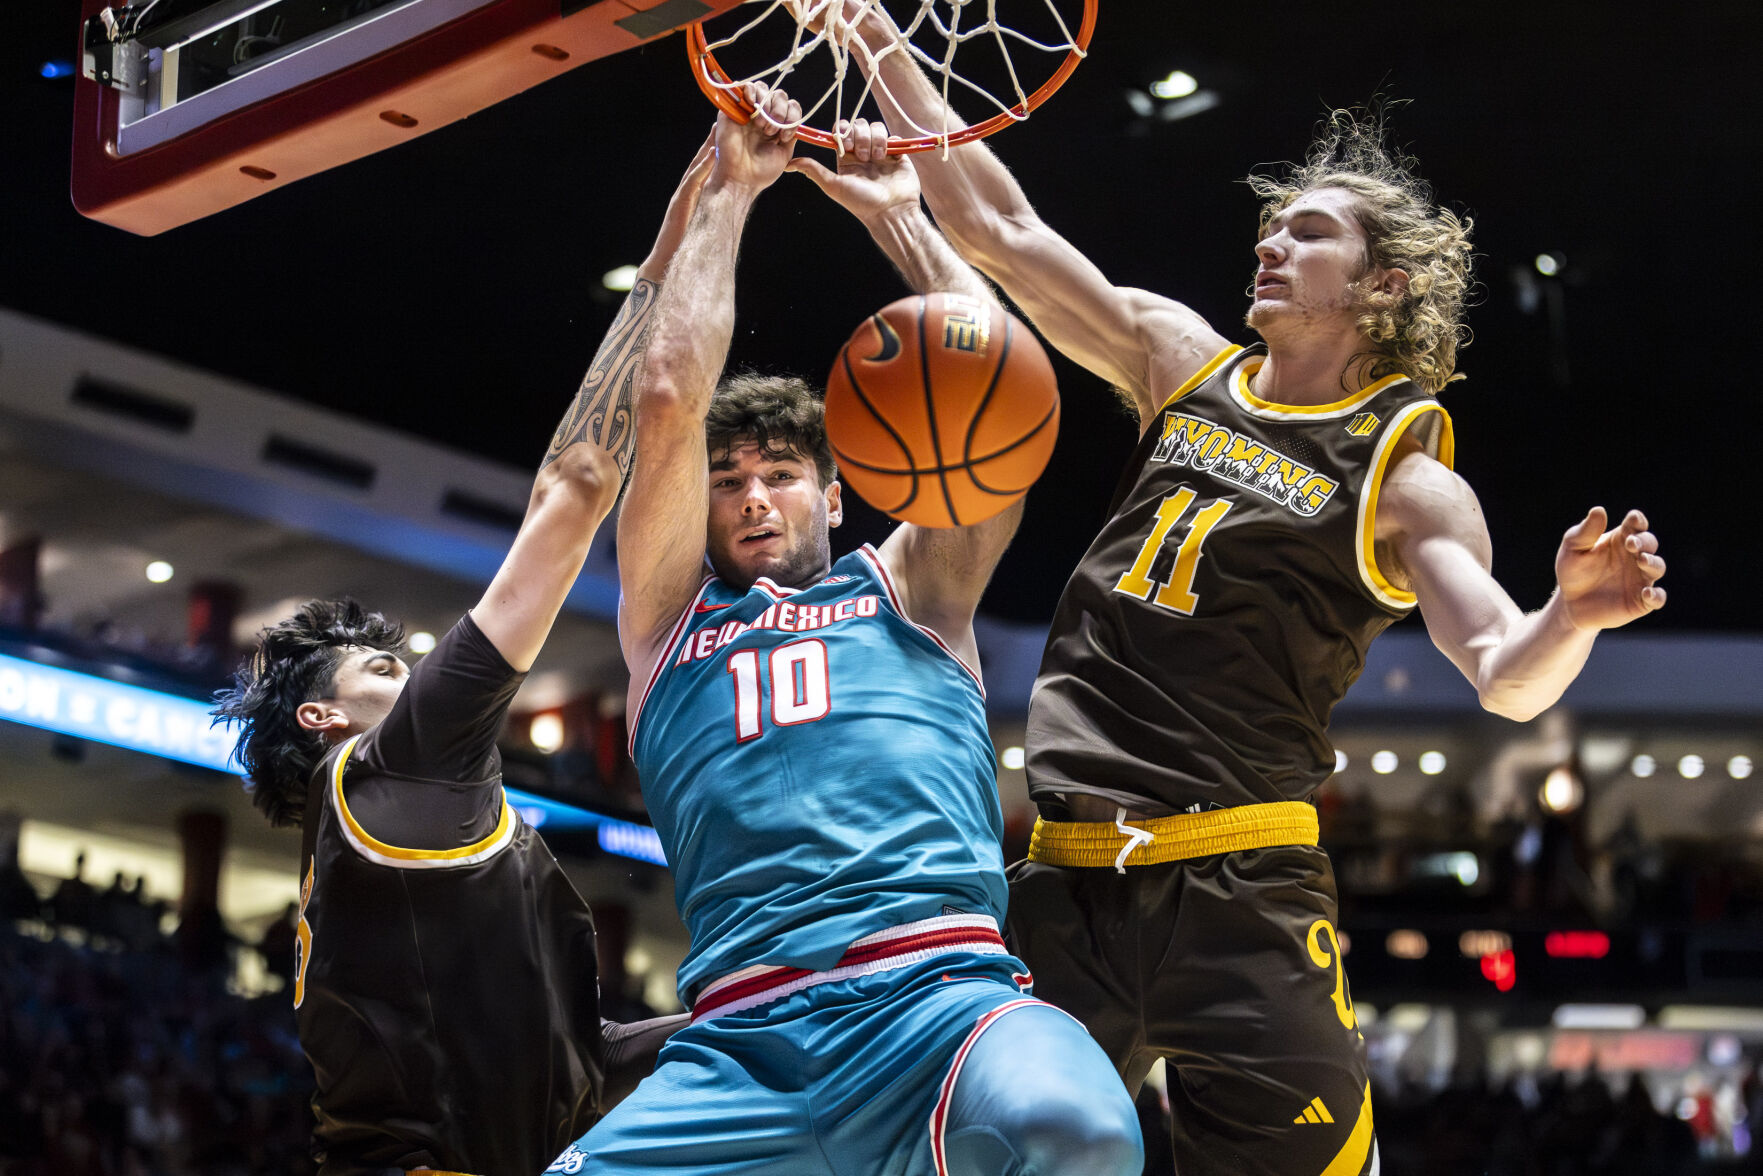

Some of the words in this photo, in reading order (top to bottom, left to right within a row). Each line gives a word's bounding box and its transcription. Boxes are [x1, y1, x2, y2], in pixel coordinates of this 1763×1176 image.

[1150, 411, 1341, 517] WYOMING
[1113, 486, 1234, 617] 11
[673, 621, 748, 669] NEW
[744, 595, 879, 632] MEXICO
[726, 638, 832, 744] 10
